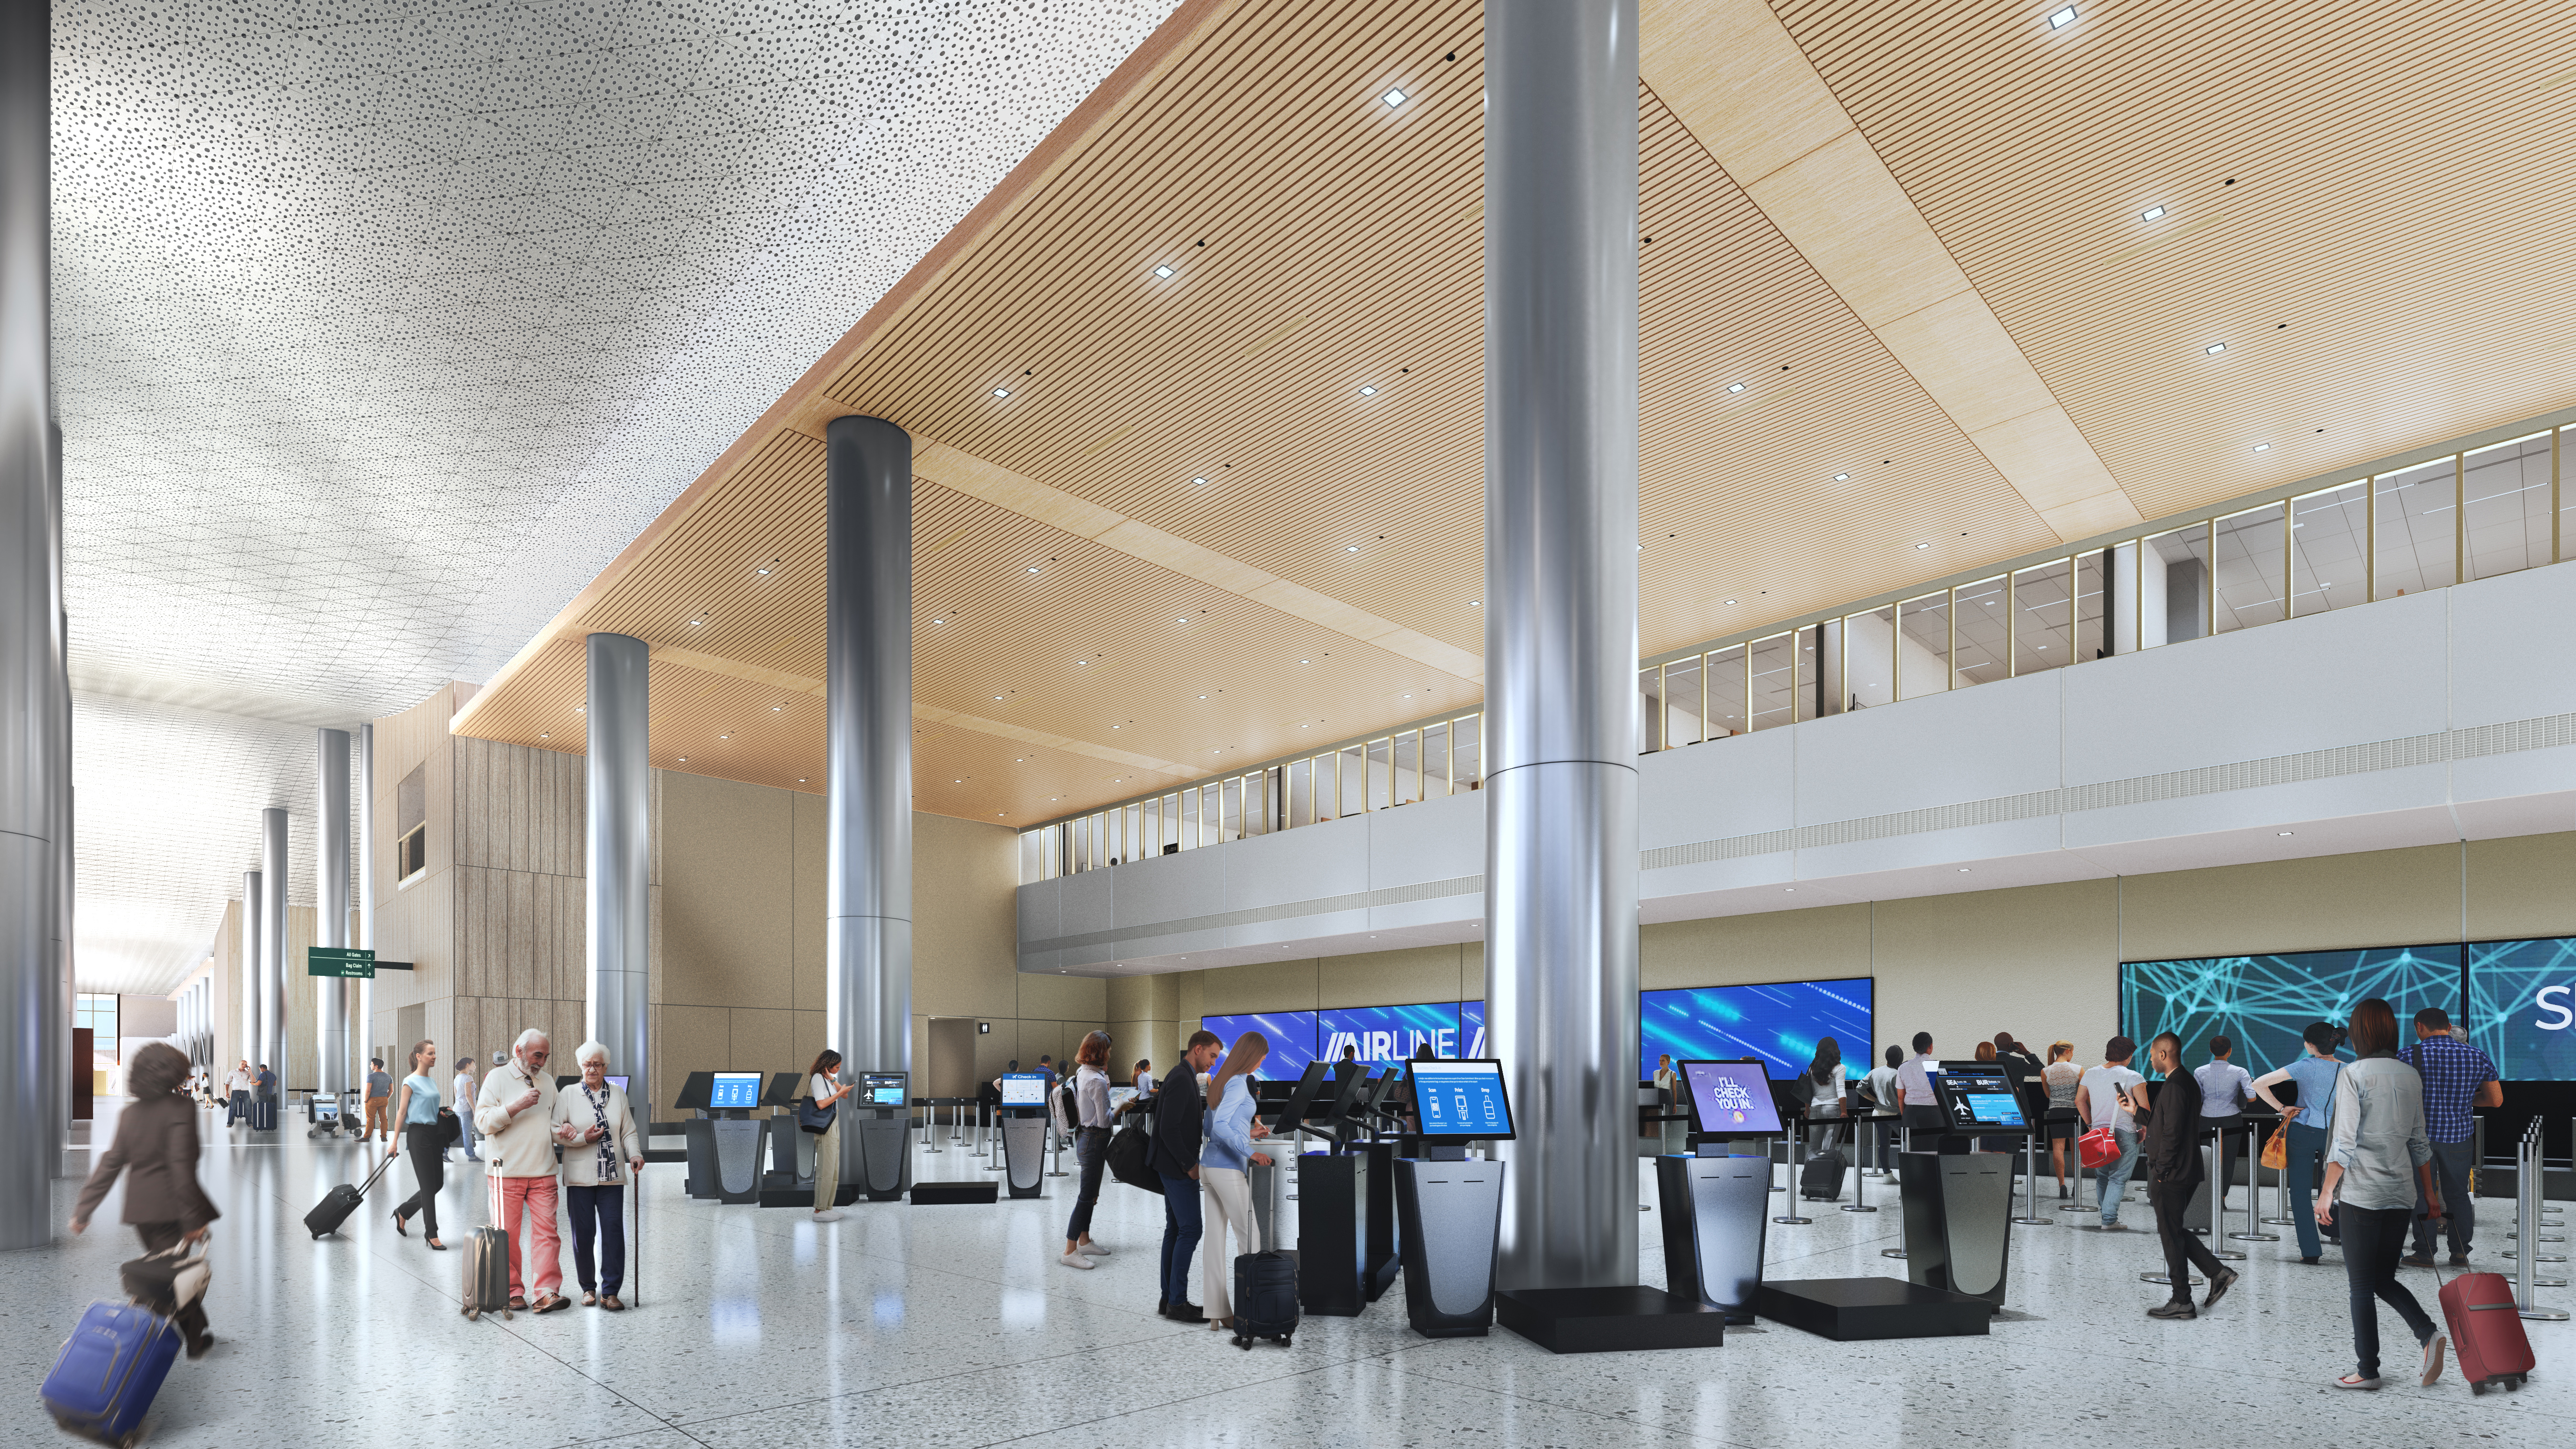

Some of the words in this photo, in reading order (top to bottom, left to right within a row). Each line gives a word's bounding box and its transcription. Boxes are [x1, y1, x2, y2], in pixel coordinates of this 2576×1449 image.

[1718, 1076, 1738, 1087] I'LL
[1714, 1087, 1750, 1098] CHECK
[1715, 1098, 1738, 1109] YOU
[1738, 1097, 1754, 1109] IN.
